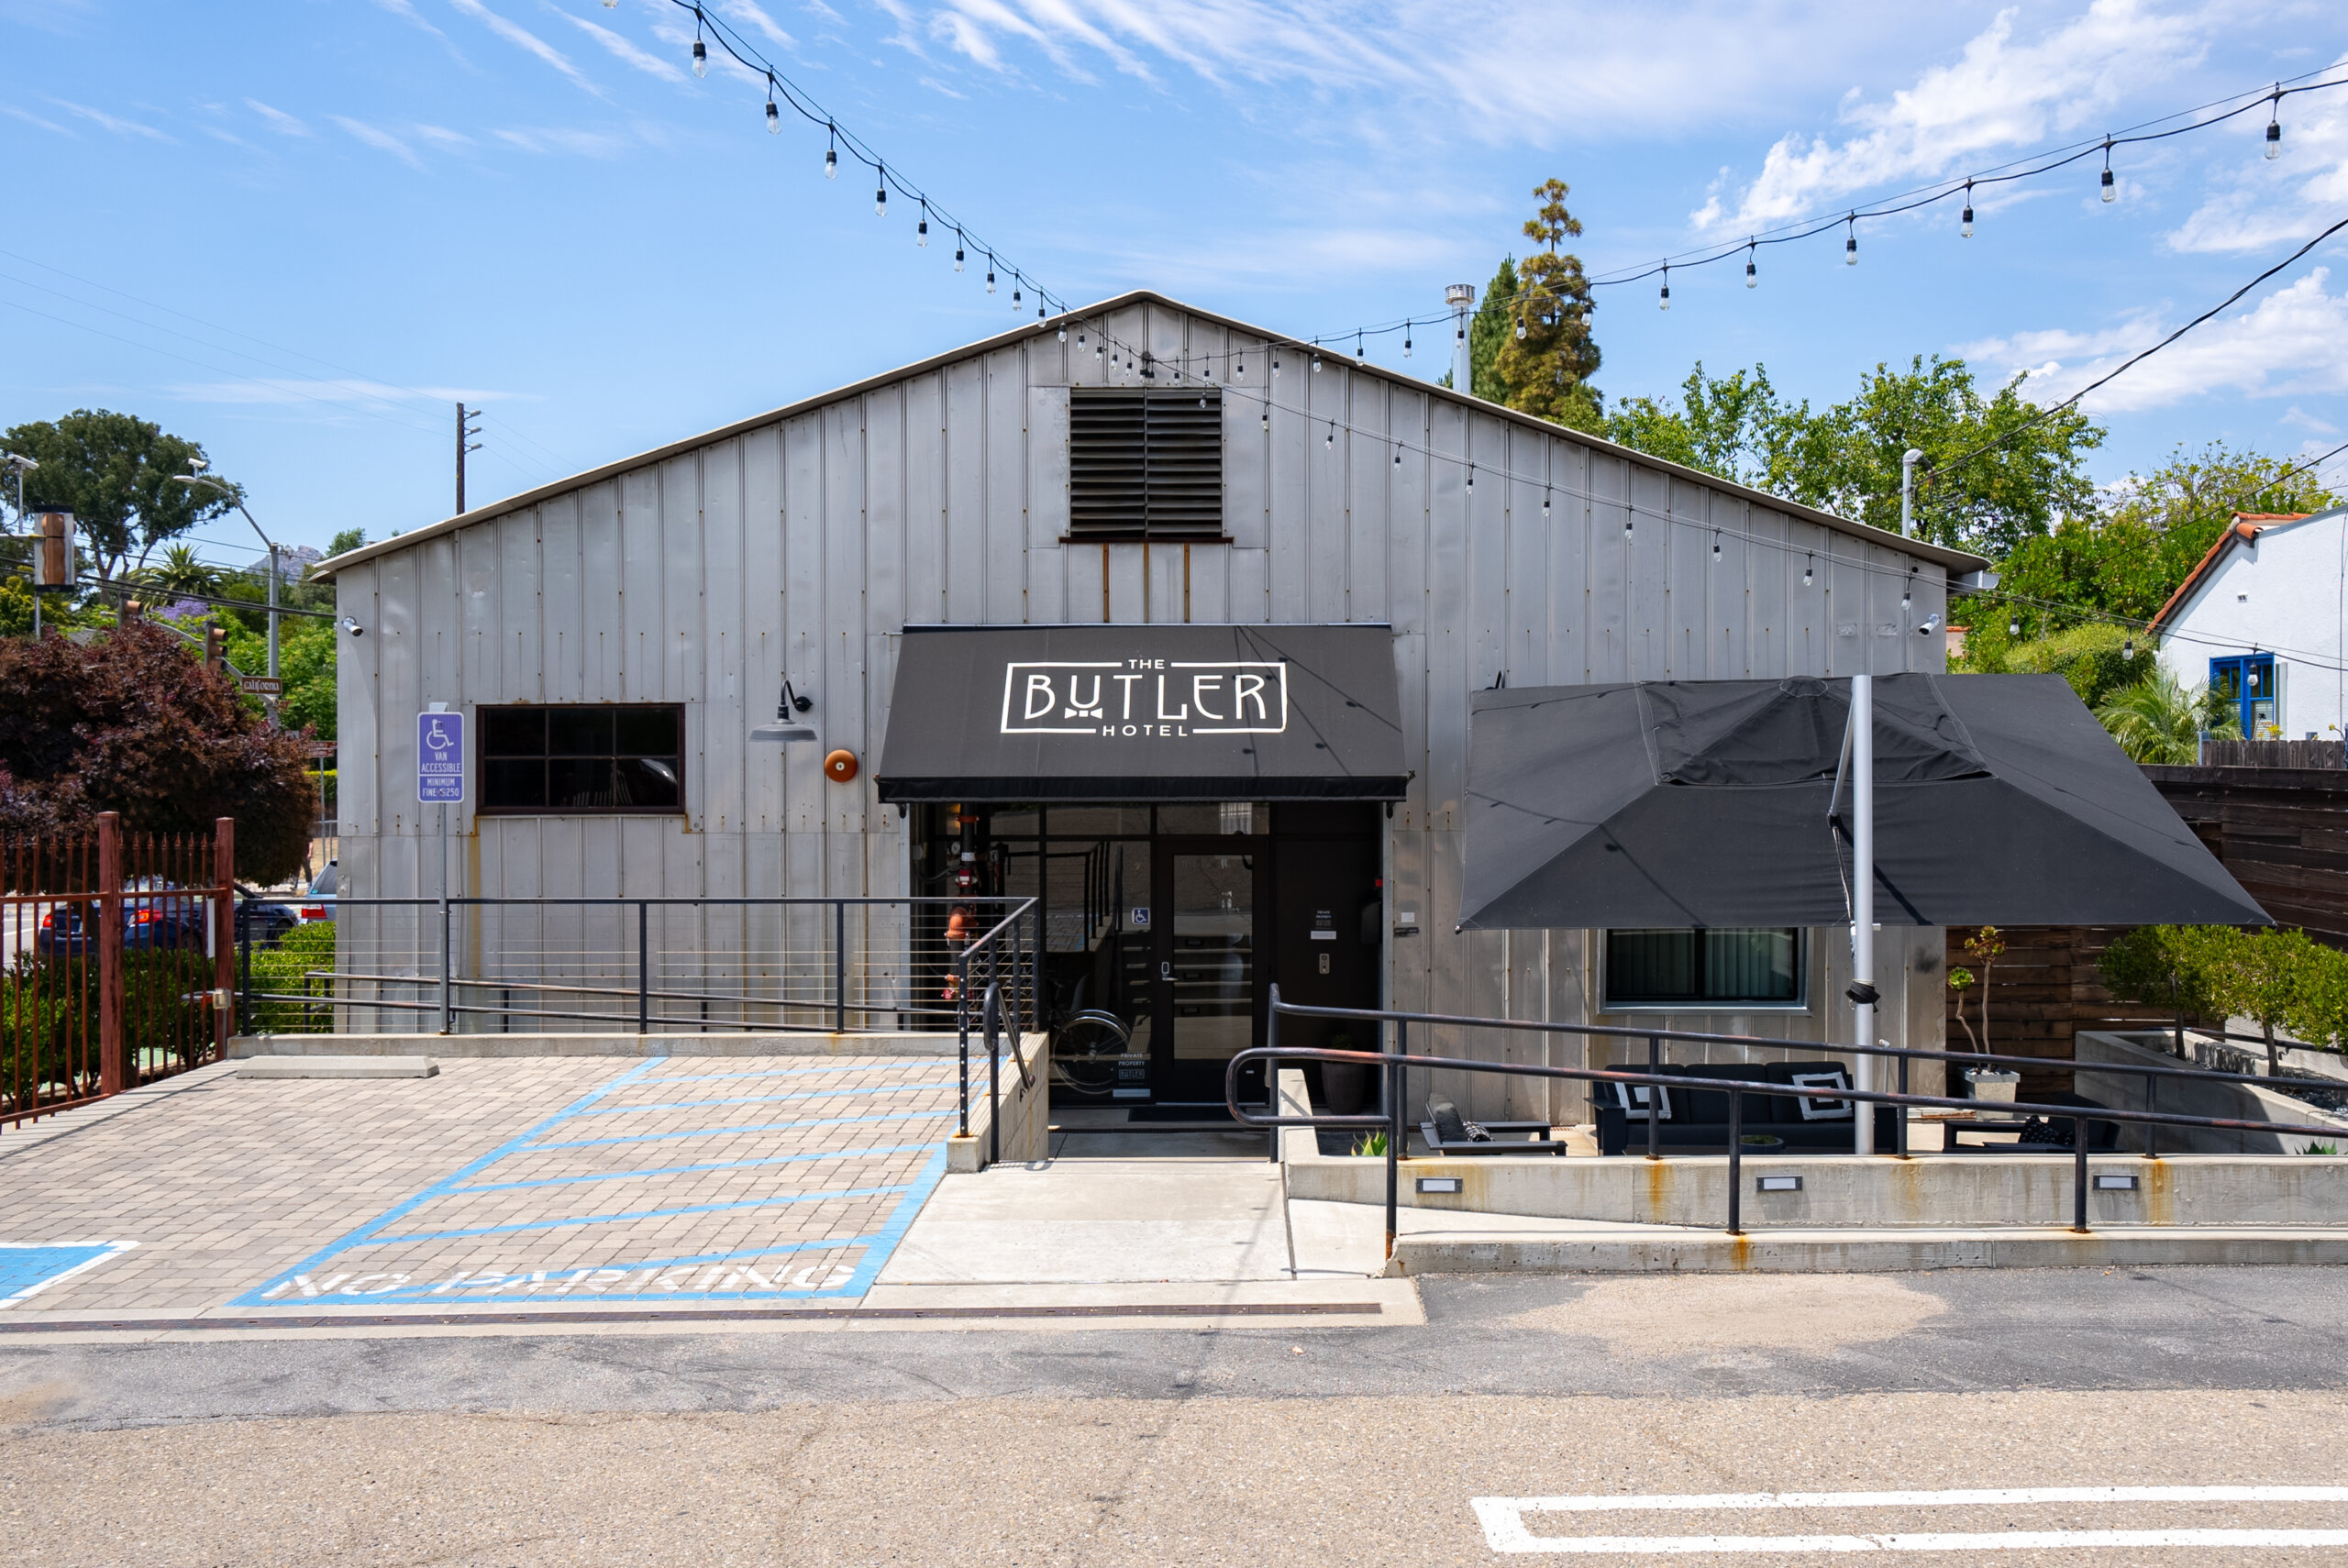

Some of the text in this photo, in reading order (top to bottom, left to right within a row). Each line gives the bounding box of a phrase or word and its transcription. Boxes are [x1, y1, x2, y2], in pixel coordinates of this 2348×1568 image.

[1128, 659, 1165, 669] THE
[1024, 675, 1267, 721] BUTLER
[1102, 724, 1189, 737] HOTEL
[434, 752, 448, 761] VAN
[421, 763, 461, 773] ACCESSIBLE
[426, 778, 455, 787] MINIMUM
[422, 788, 460, 797] FINE $250
[260, 1264, 856, 1297] NO PARKING
